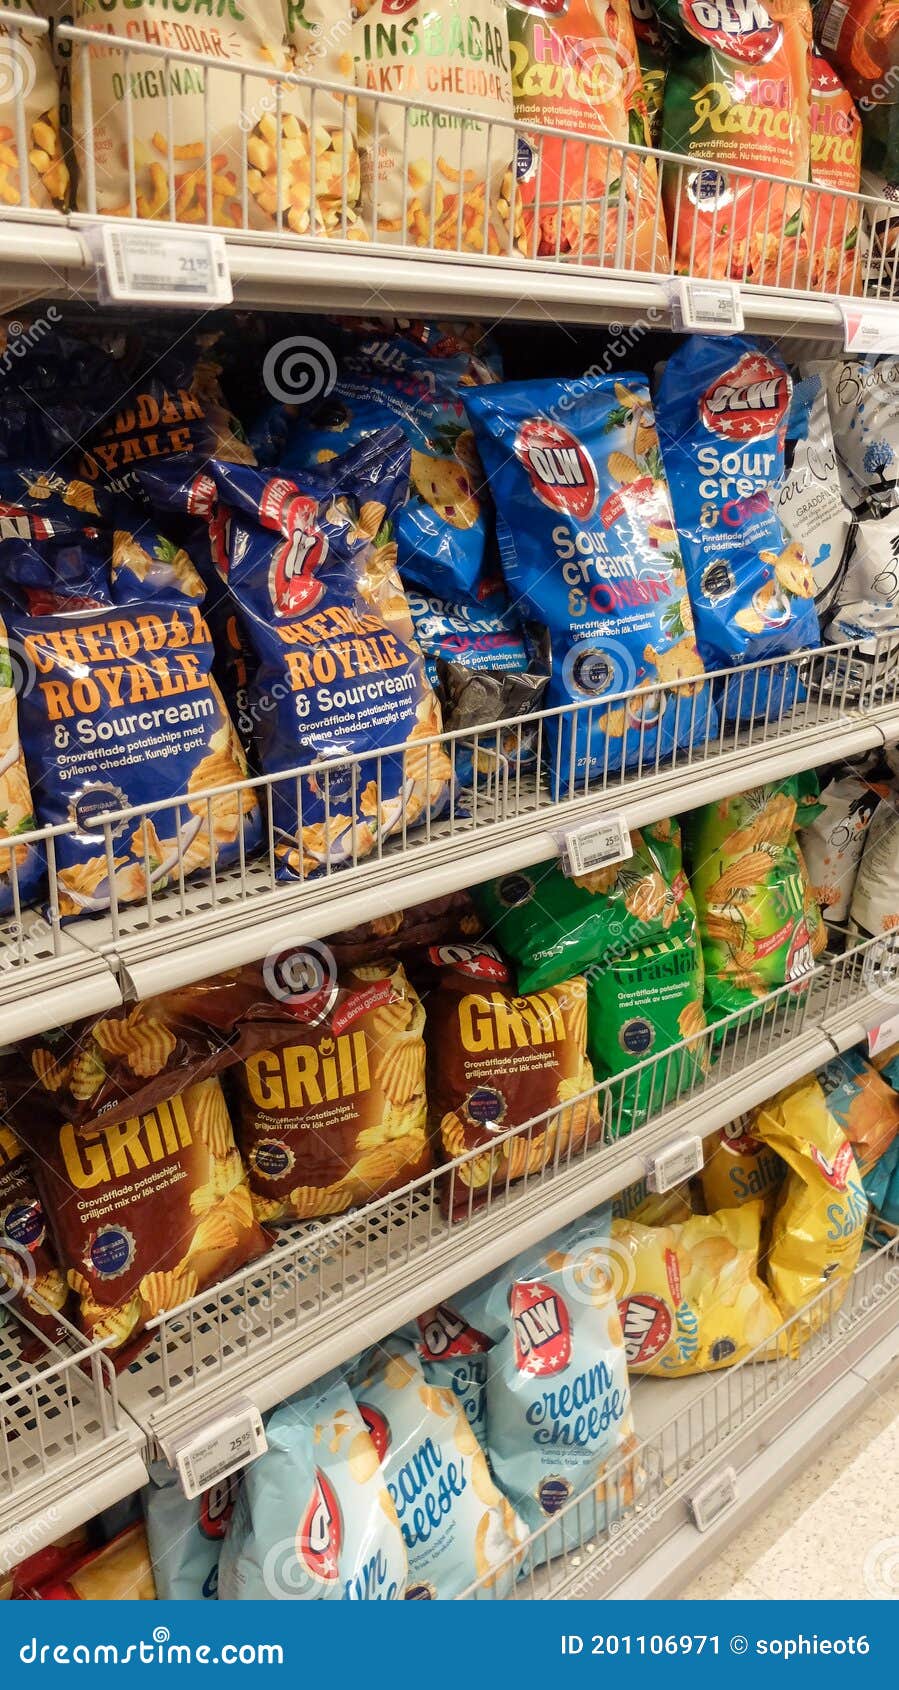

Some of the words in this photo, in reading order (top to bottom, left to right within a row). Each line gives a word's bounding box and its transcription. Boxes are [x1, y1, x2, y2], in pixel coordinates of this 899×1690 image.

[354, 0, 509, 73] INSBÅGAR
[365, 63, 420, 93] ÄKTA
[427, 66, 504, 103] CHEDDAR
[690, 82, 801, 144] Ranch
[689, 140, 738, 150] Grovräfflade
[716, 151, 738, 160] smak.
[705, 376, 785, 415] OLW
[528, 446, 586, 488] OLW
[697, 447, 776, 477] Sour
[699, 501, 720, 529] &
[552, 525, 607, 559] Sour
[562, 553, 638, 587] cream
[567, 588, 589, 617] &
[588, 572, 673, 614] ONION
[569, 619, 617, 632] Finräfflade
[285, 635, 409, 692] ROYALE
[472, 652, 512, 665] potatischips
[38, 654, 210, 721] ROYALE
[295, 694, 311, 718] &
[316, 673, 417, 712] Sourcream
[54, 724, 70, 749] &
[77, 698, 215, 744] Sourcream
[298, 712, 356, 733] Grovräfflade
[357, 700, 399, 719] potatischips
[399, 696, 413, 707] med
[300, 730, 333, 747] gyllene
[334, 720, 373, 737] cheddar.
[372, 712, 400, 726] Kungligt
[56, 745, 125, 766] Grovräfflade
[127, 732, 182, 754] potatischips
[183, 724, 205, 737] med
[59, 764, 98, 780] gyllene
[100, 754, 145, 770] cheddar.
[145, 743, 182, 761] Kungligt
[183, 738, 206, 752] gott.
[618, 999, 634, 1008] med
[634, 997, 651, 1005] smak
[463, 1057, 512, 1069] Grovräfflade
[512, 1053, 552, 1065] potatischips
[465, 1068, 493, 1080] grilljant
[493, 1066, 507, 1075] mix
[519, 1064, 531, 1072] lök
[531, 1062, 544, 1070] och
[284, 1122, 299, 1130] mix
[300, 1122, 311, 1130] av
[312, 1122, 325, 1130] lök
[325, 1116, 341, 1127] och
[305, 1105, 351, 1122] potatischips
[77, 1185, 134, 1210] Grovräfflade
[134, 1164, 178, 1191] potatischips
[80, 1203, 114, 1223] grilljant
[114, 1197, 130, 1210] mix
[131, 1192, 141, 1202] av
[142, 1186, 155, 1198] lök
[155, 1180, 170, 1191] och
[170, 1171, 188, 1185] sälta.
[525, 1360, 614, 1425] cream
[534, 1388, 627, 1447] cheese
